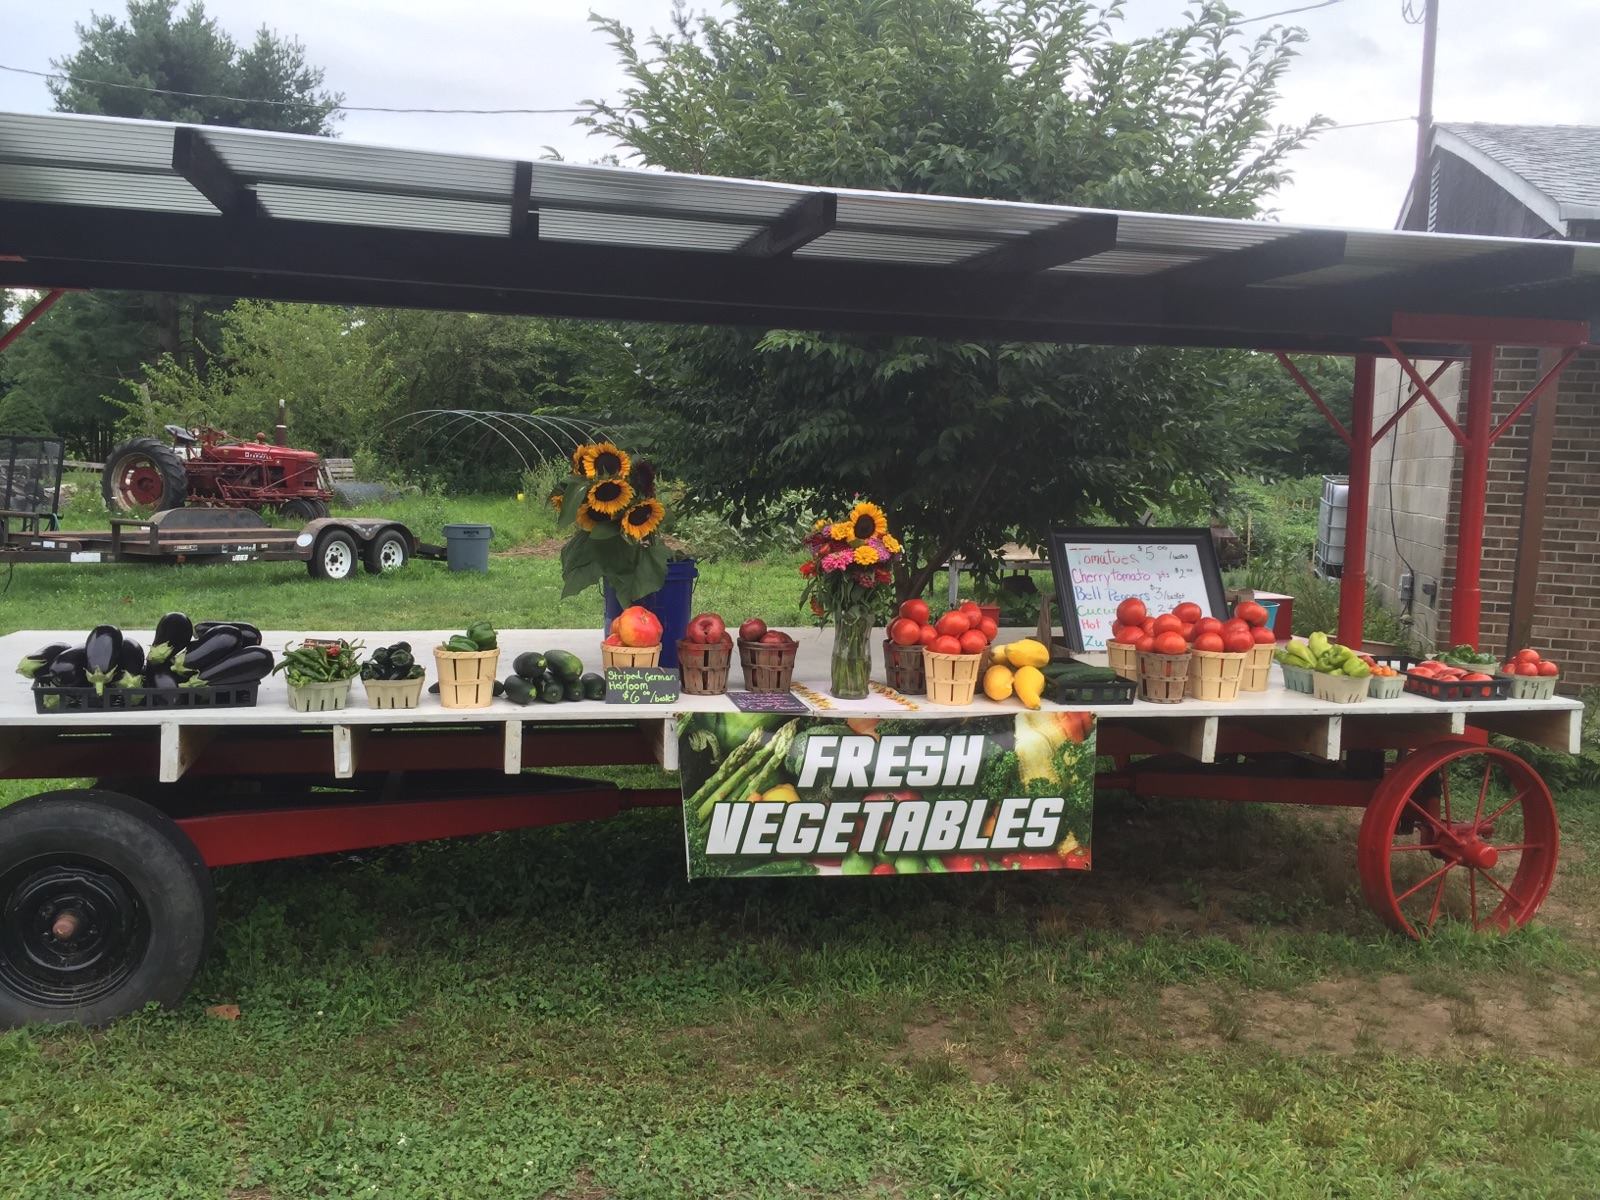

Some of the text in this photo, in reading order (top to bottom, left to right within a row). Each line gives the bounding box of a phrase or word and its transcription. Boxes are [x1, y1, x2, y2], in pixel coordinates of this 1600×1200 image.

[1075, 585, 1102, 601] Bell
[1081, 618, 1101, 630] Hot
[1083, 634, 1105, 648] Zu
[607, 669, 677, 686] Striped German
[608, 680, 648, 691] Heirloom
[797, 735, 985, 788] FRESH
[705, 797, 1065, 855] VEGETABLES
